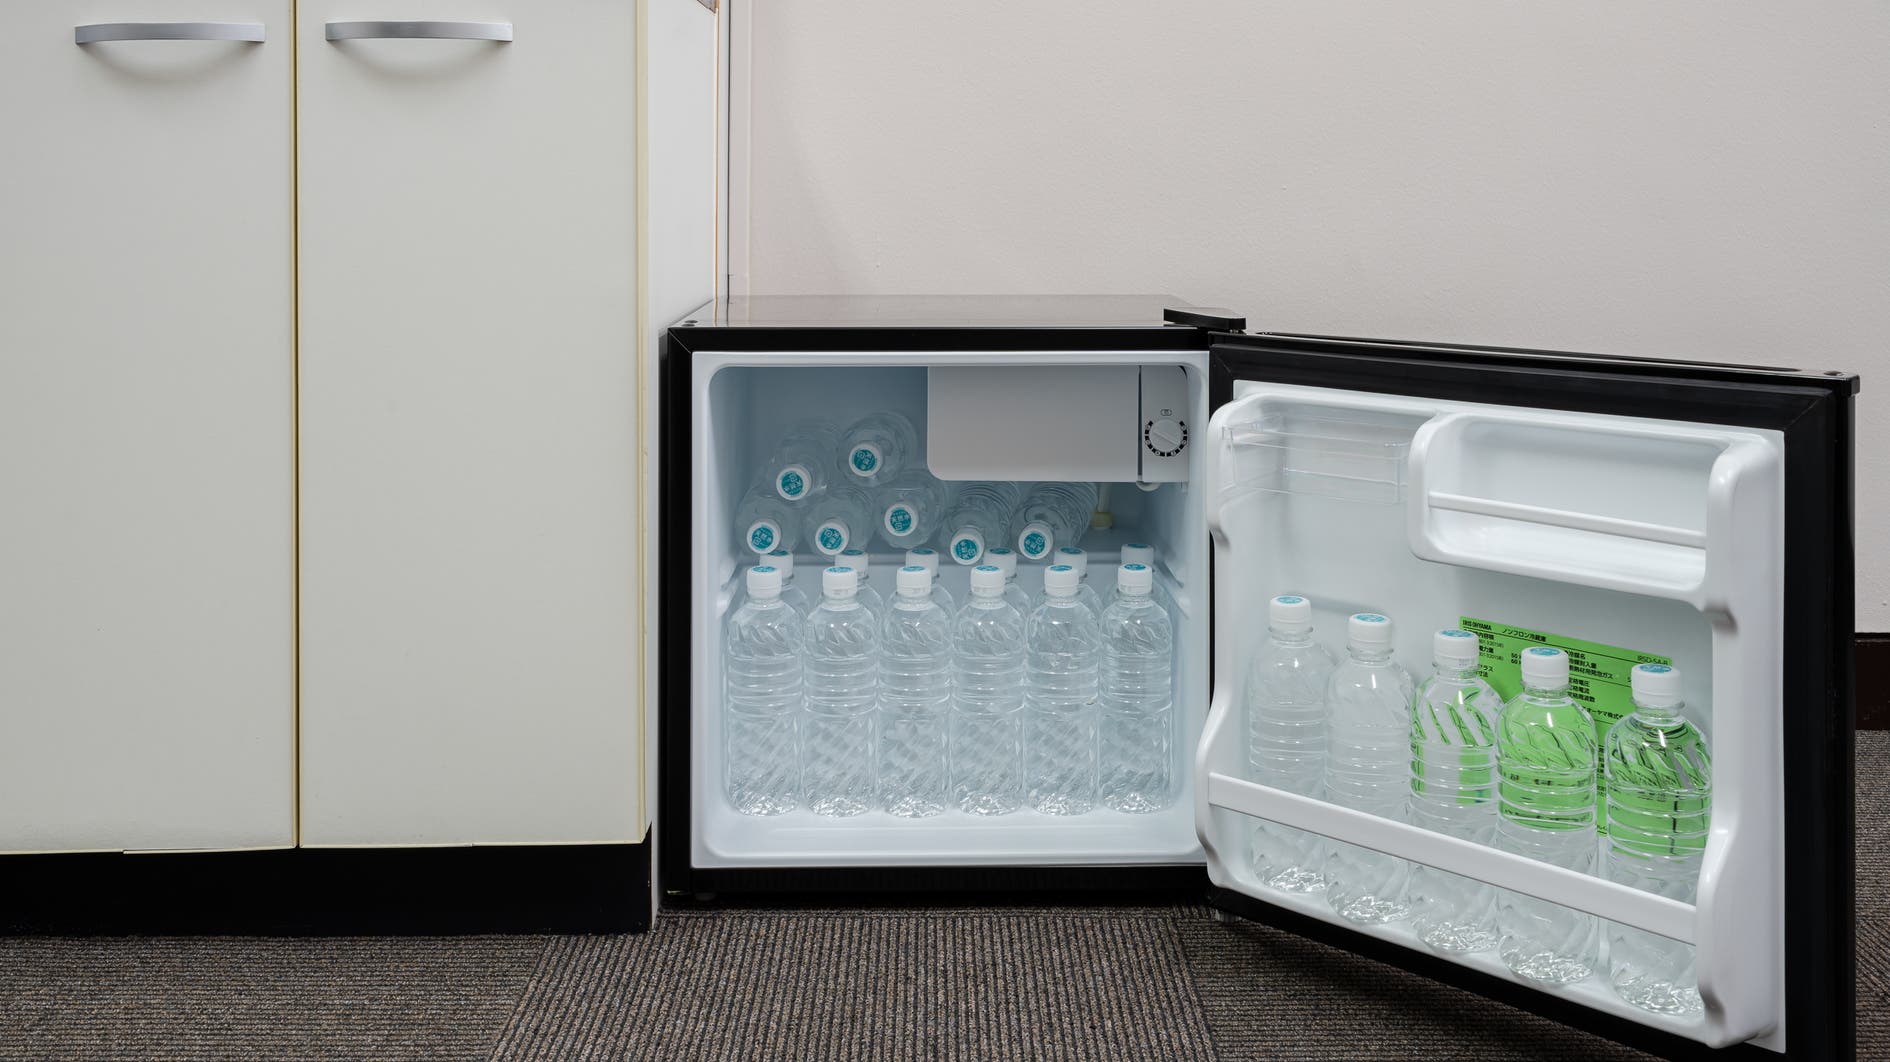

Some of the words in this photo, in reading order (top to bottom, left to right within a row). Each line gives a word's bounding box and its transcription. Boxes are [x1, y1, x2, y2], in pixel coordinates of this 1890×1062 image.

[1472, 621, 1492, 631] OHYAMA
[1502, 628, 1546, 642] ノンフロン冷蔵庫
[1479, 645, 1494, 653] 電力量
